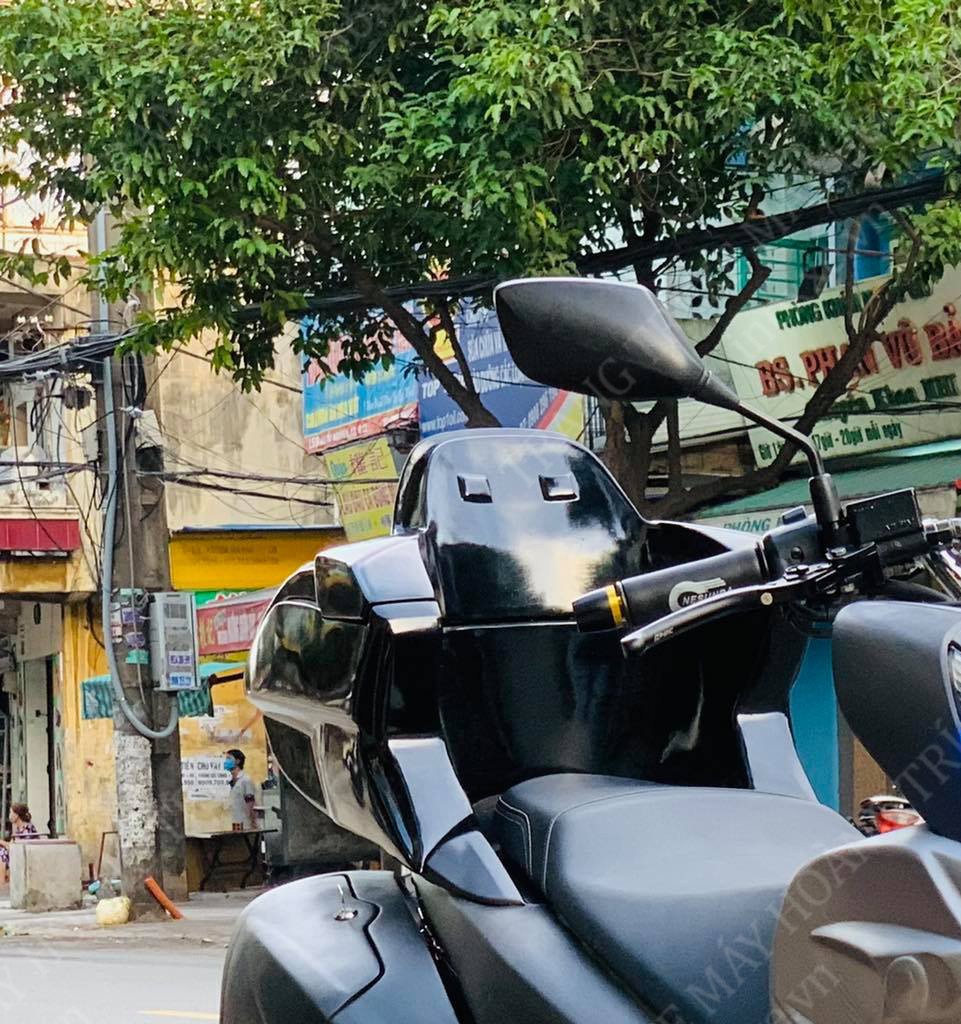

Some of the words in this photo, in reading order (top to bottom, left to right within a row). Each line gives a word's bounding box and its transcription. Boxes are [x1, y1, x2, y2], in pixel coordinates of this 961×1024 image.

[775, 301, 823, 330] PHÒNG
[755, 356, 805, 398] BS.
[882, 317, 923, 370] VŨ
[422, 381, 440, 399] TOP
